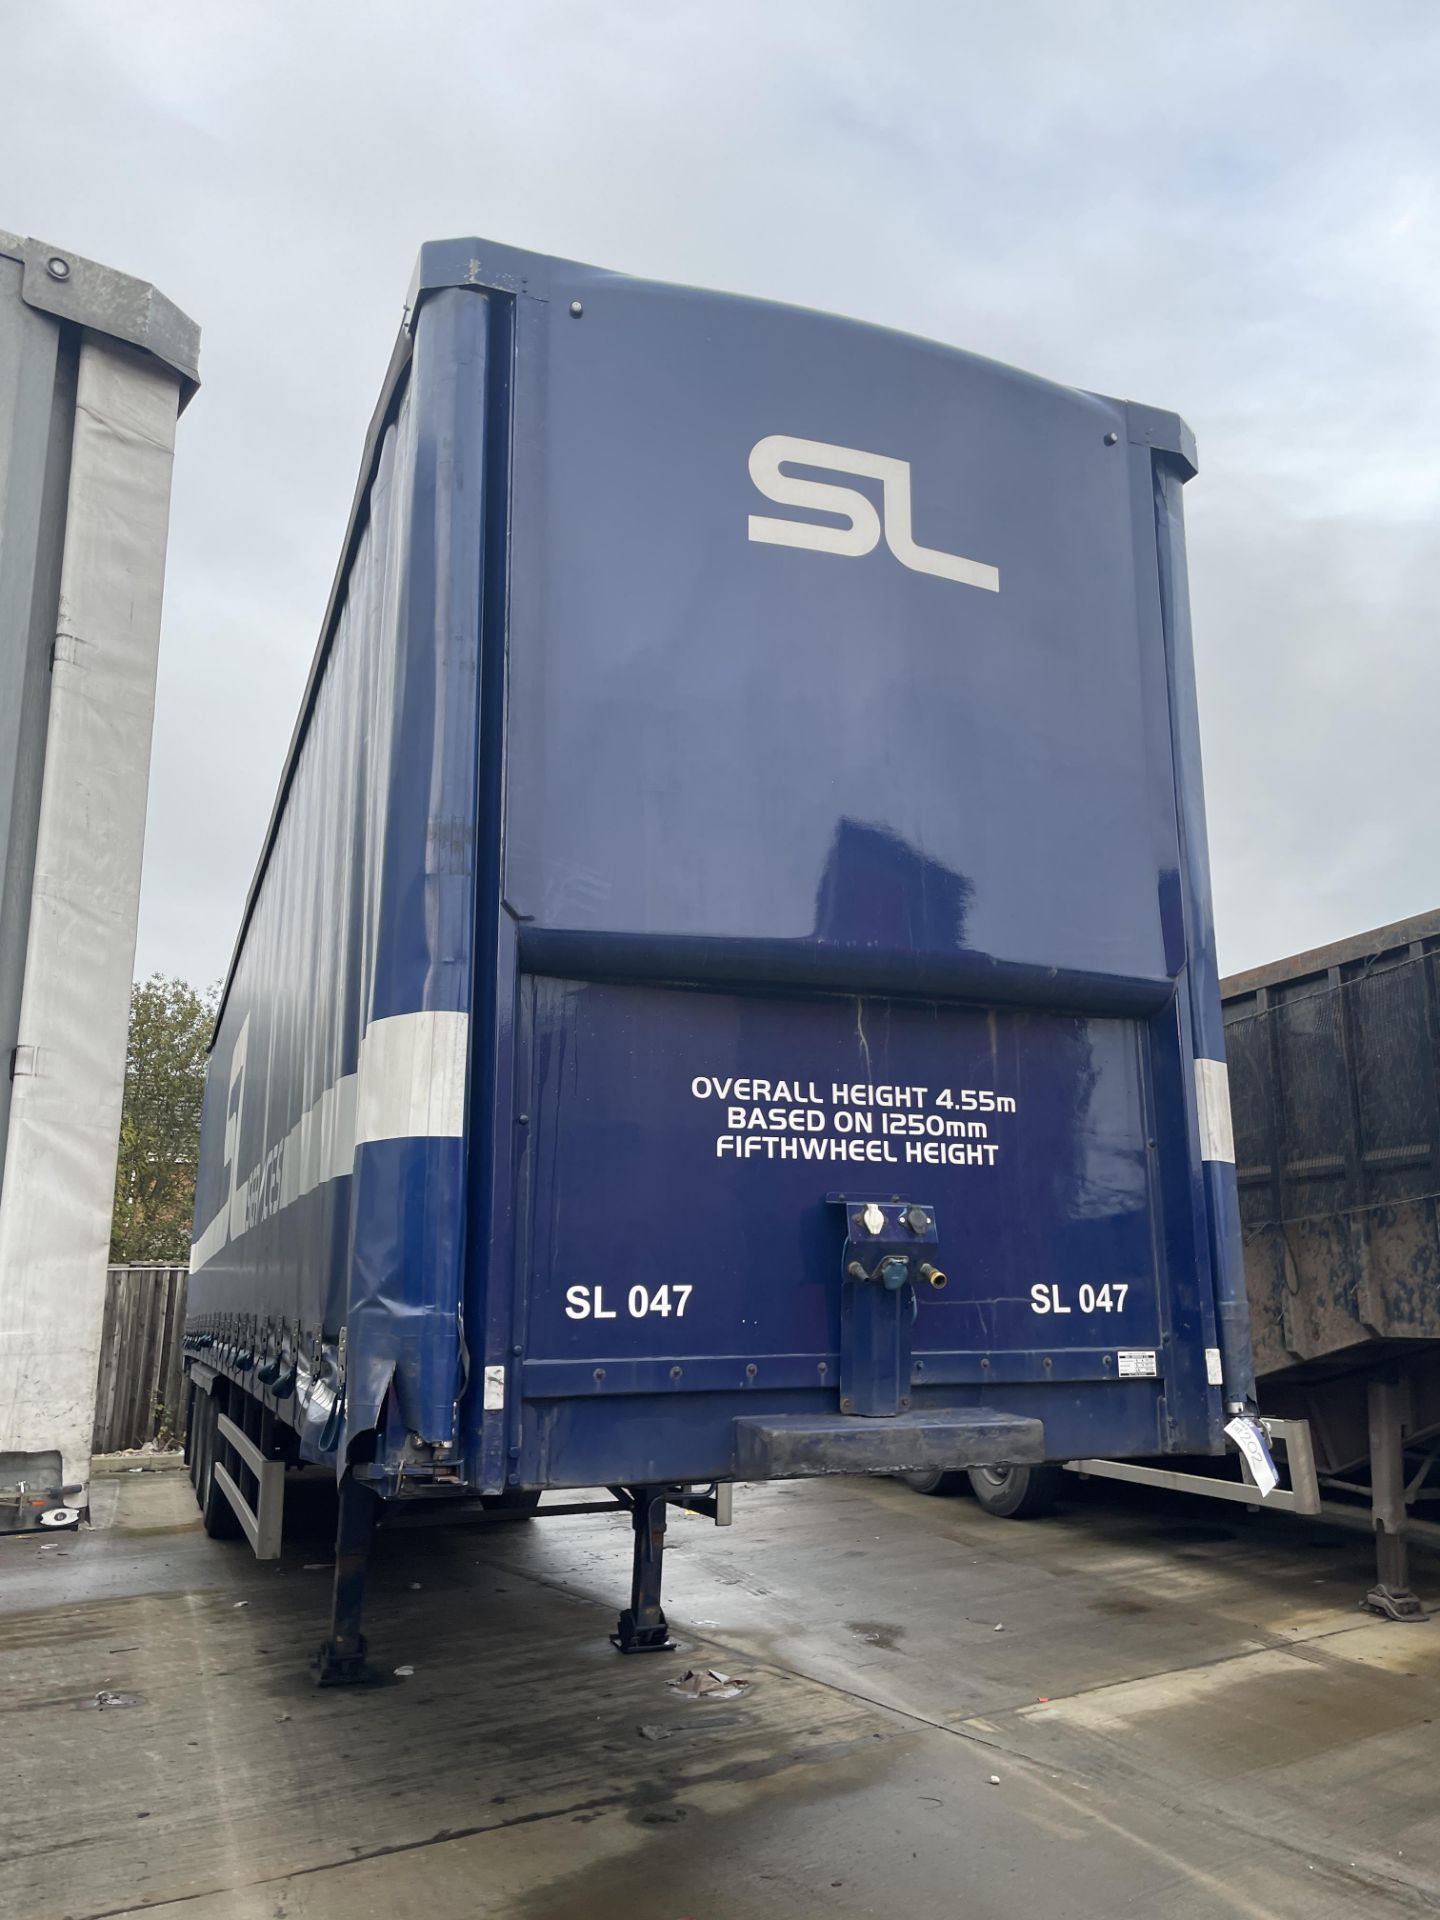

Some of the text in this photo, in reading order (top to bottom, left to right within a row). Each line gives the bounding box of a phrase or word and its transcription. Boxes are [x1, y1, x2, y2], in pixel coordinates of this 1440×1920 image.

[748, 434, 1000, 593] SL
[691, 1076, 1016, 1113] OVERALL HEIGHT 4.55m
[727, 1106, 988, 1139] BASED ON 1250mm
[716, 1135, 999, 1166] FIFTHWHEEL HEIGHT
[565, 1284, 693, 1320] SL 047
[1030, 1283, 1129, 1314] SL 047
